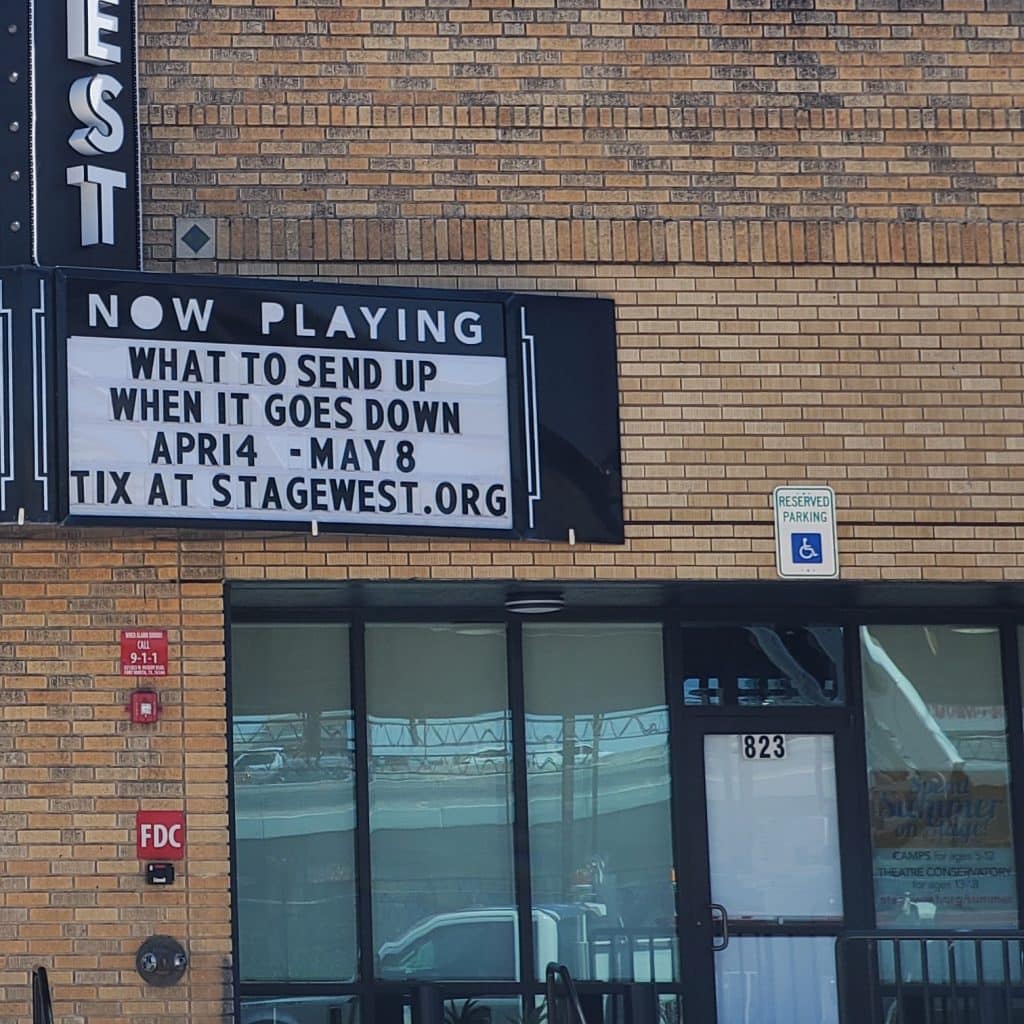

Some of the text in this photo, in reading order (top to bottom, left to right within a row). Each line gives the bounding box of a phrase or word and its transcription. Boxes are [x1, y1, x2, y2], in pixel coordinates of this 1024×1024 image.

[88, 293, 483, 345] NOW PLAYING
[128, 346, 438, 392] WHAT TO SEND UP
[110, 387, 461, 434] WHEN IT GOES DOWN
[396, 440, 416, 474] 8
[71, 470, 507, 517] TIX AT STAGEWEST.ORG
[779, 496, 830, 508] RESERVED
[783, 511, 828, 523] PARKING
[130, 652, 158, 664] 9-1-1
[744, 735, 785, 758] 823
[141, 824, 181, 848] FDC
